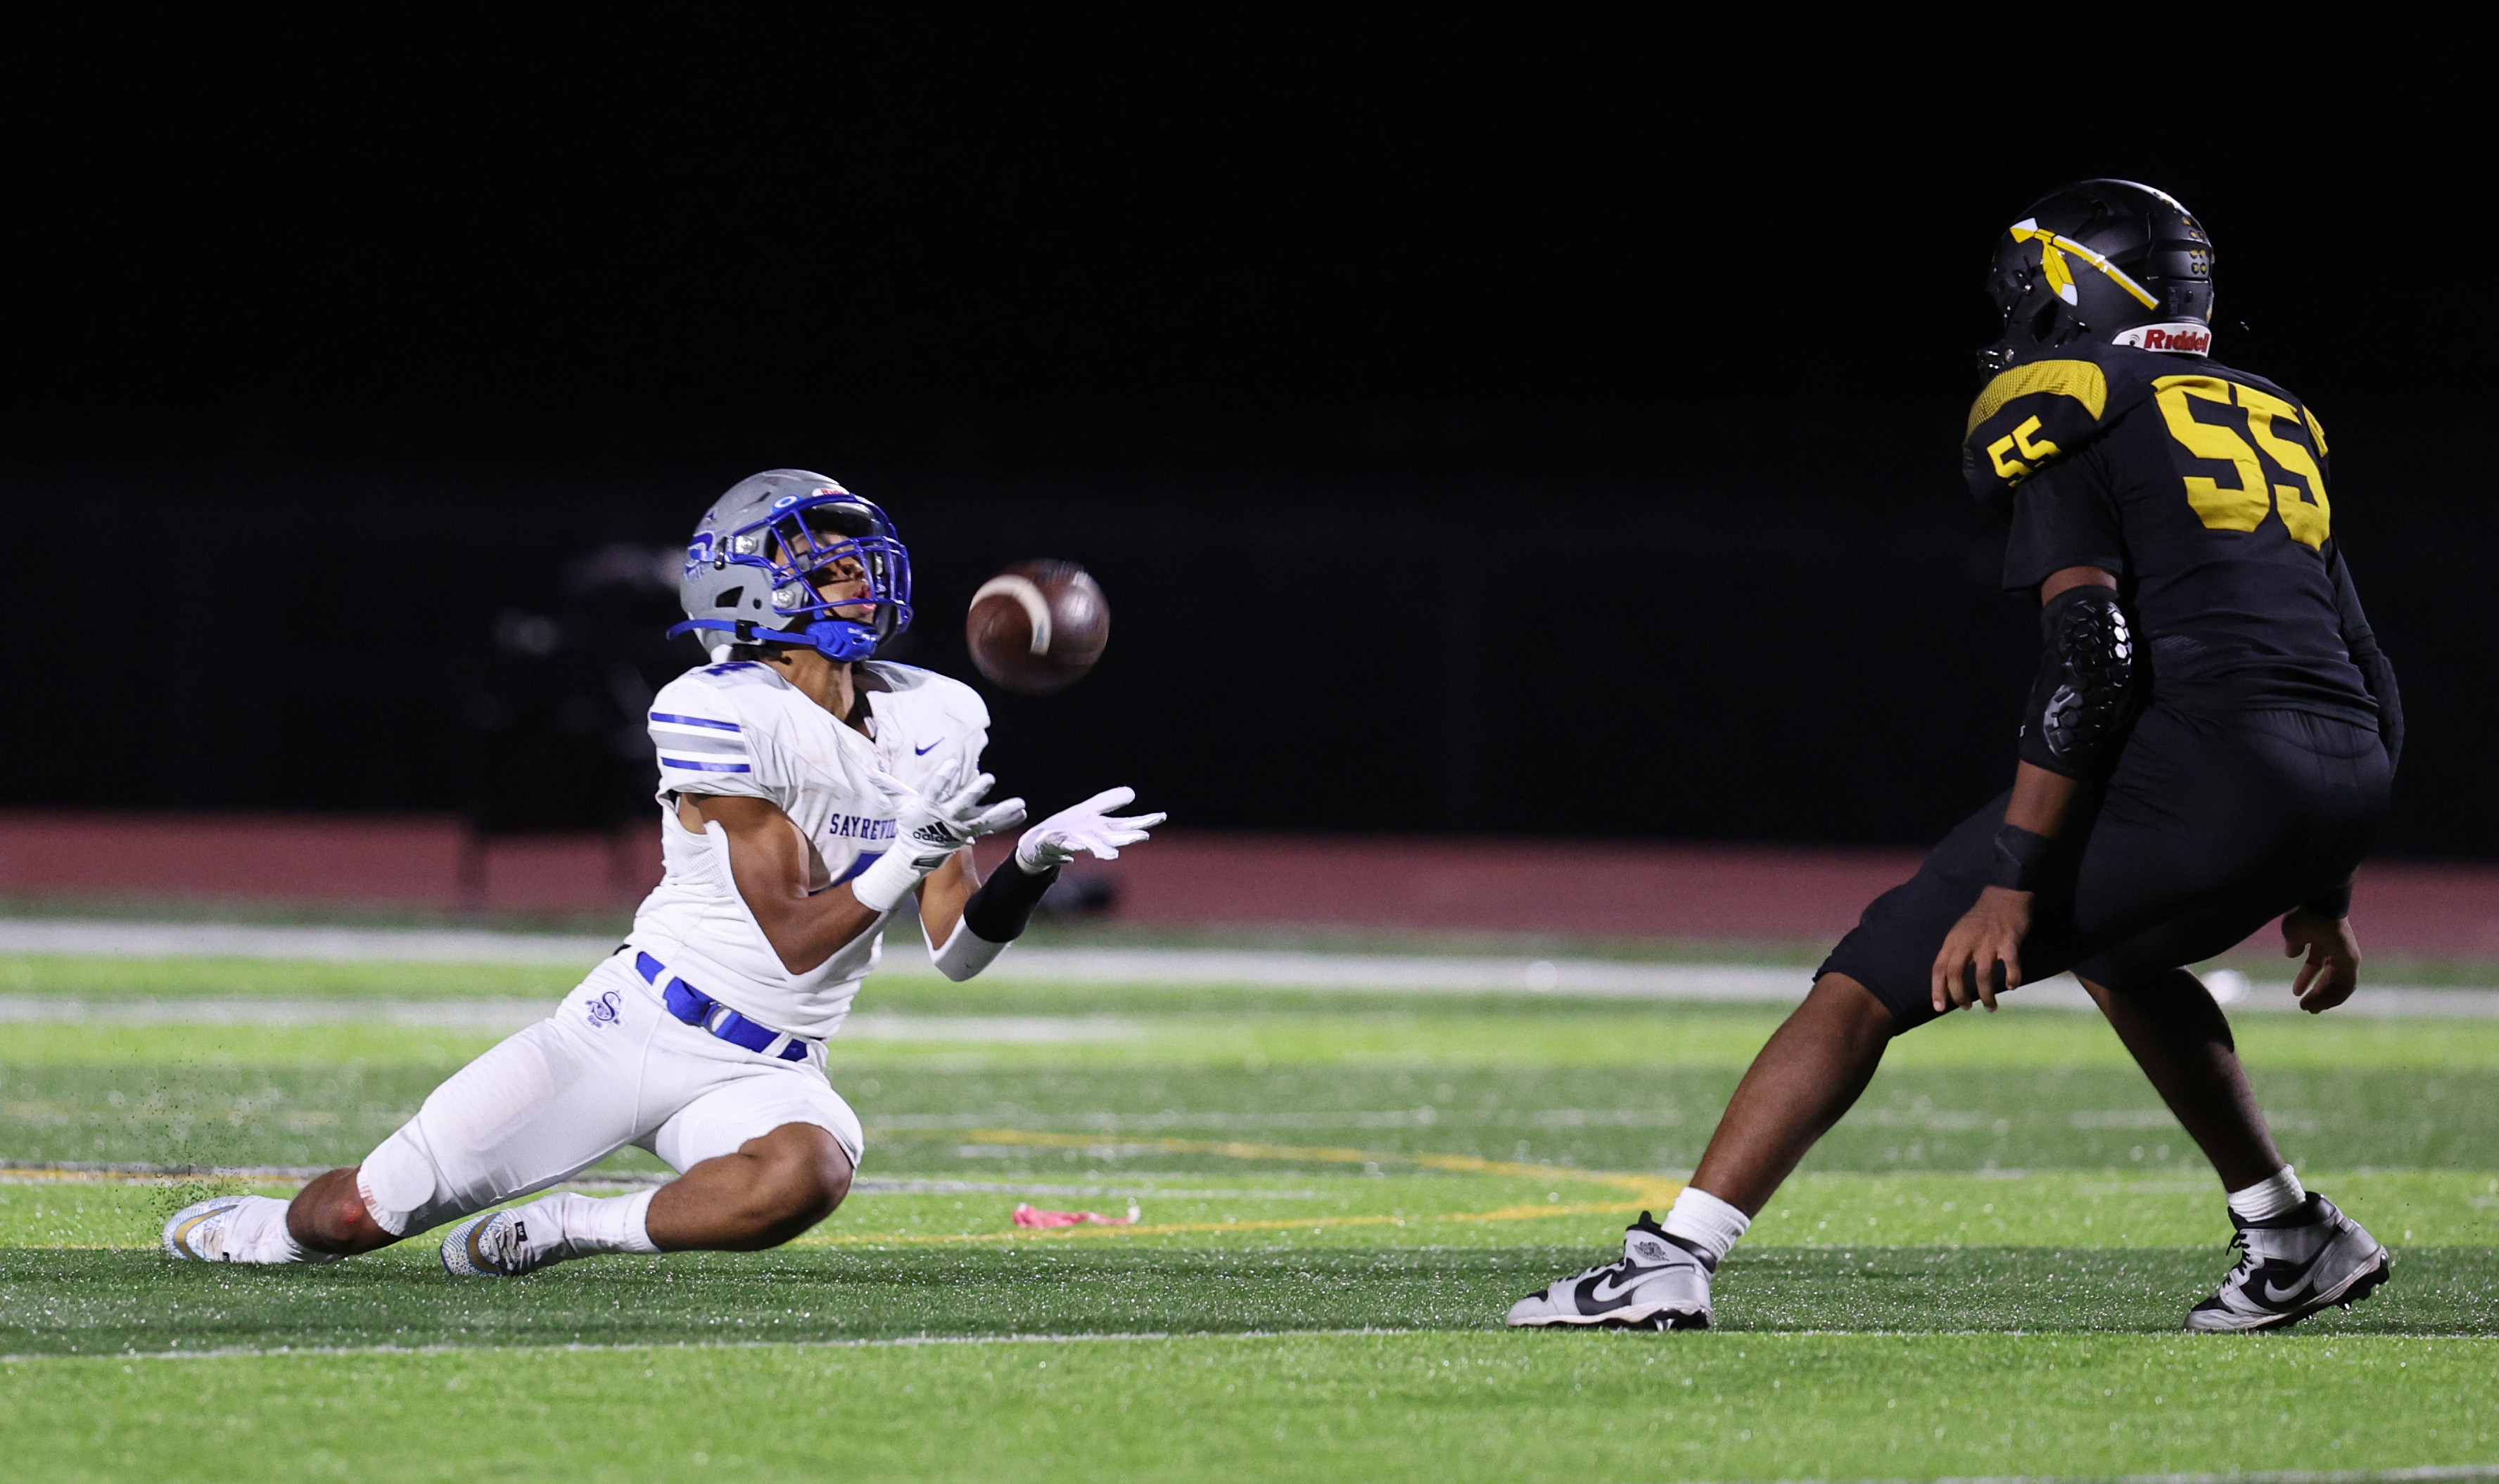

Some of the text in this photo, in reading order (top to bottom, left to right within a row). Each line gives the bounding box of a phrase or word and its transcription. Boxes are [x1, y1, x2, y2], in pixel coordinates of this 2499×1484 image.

[2144, 329, 2210, 352] Riddel
[1986, 414, 2063, 487] 55
[2151, 375, 2331, 551] 55
[829, 813, 898, 840] SAYREVIL
